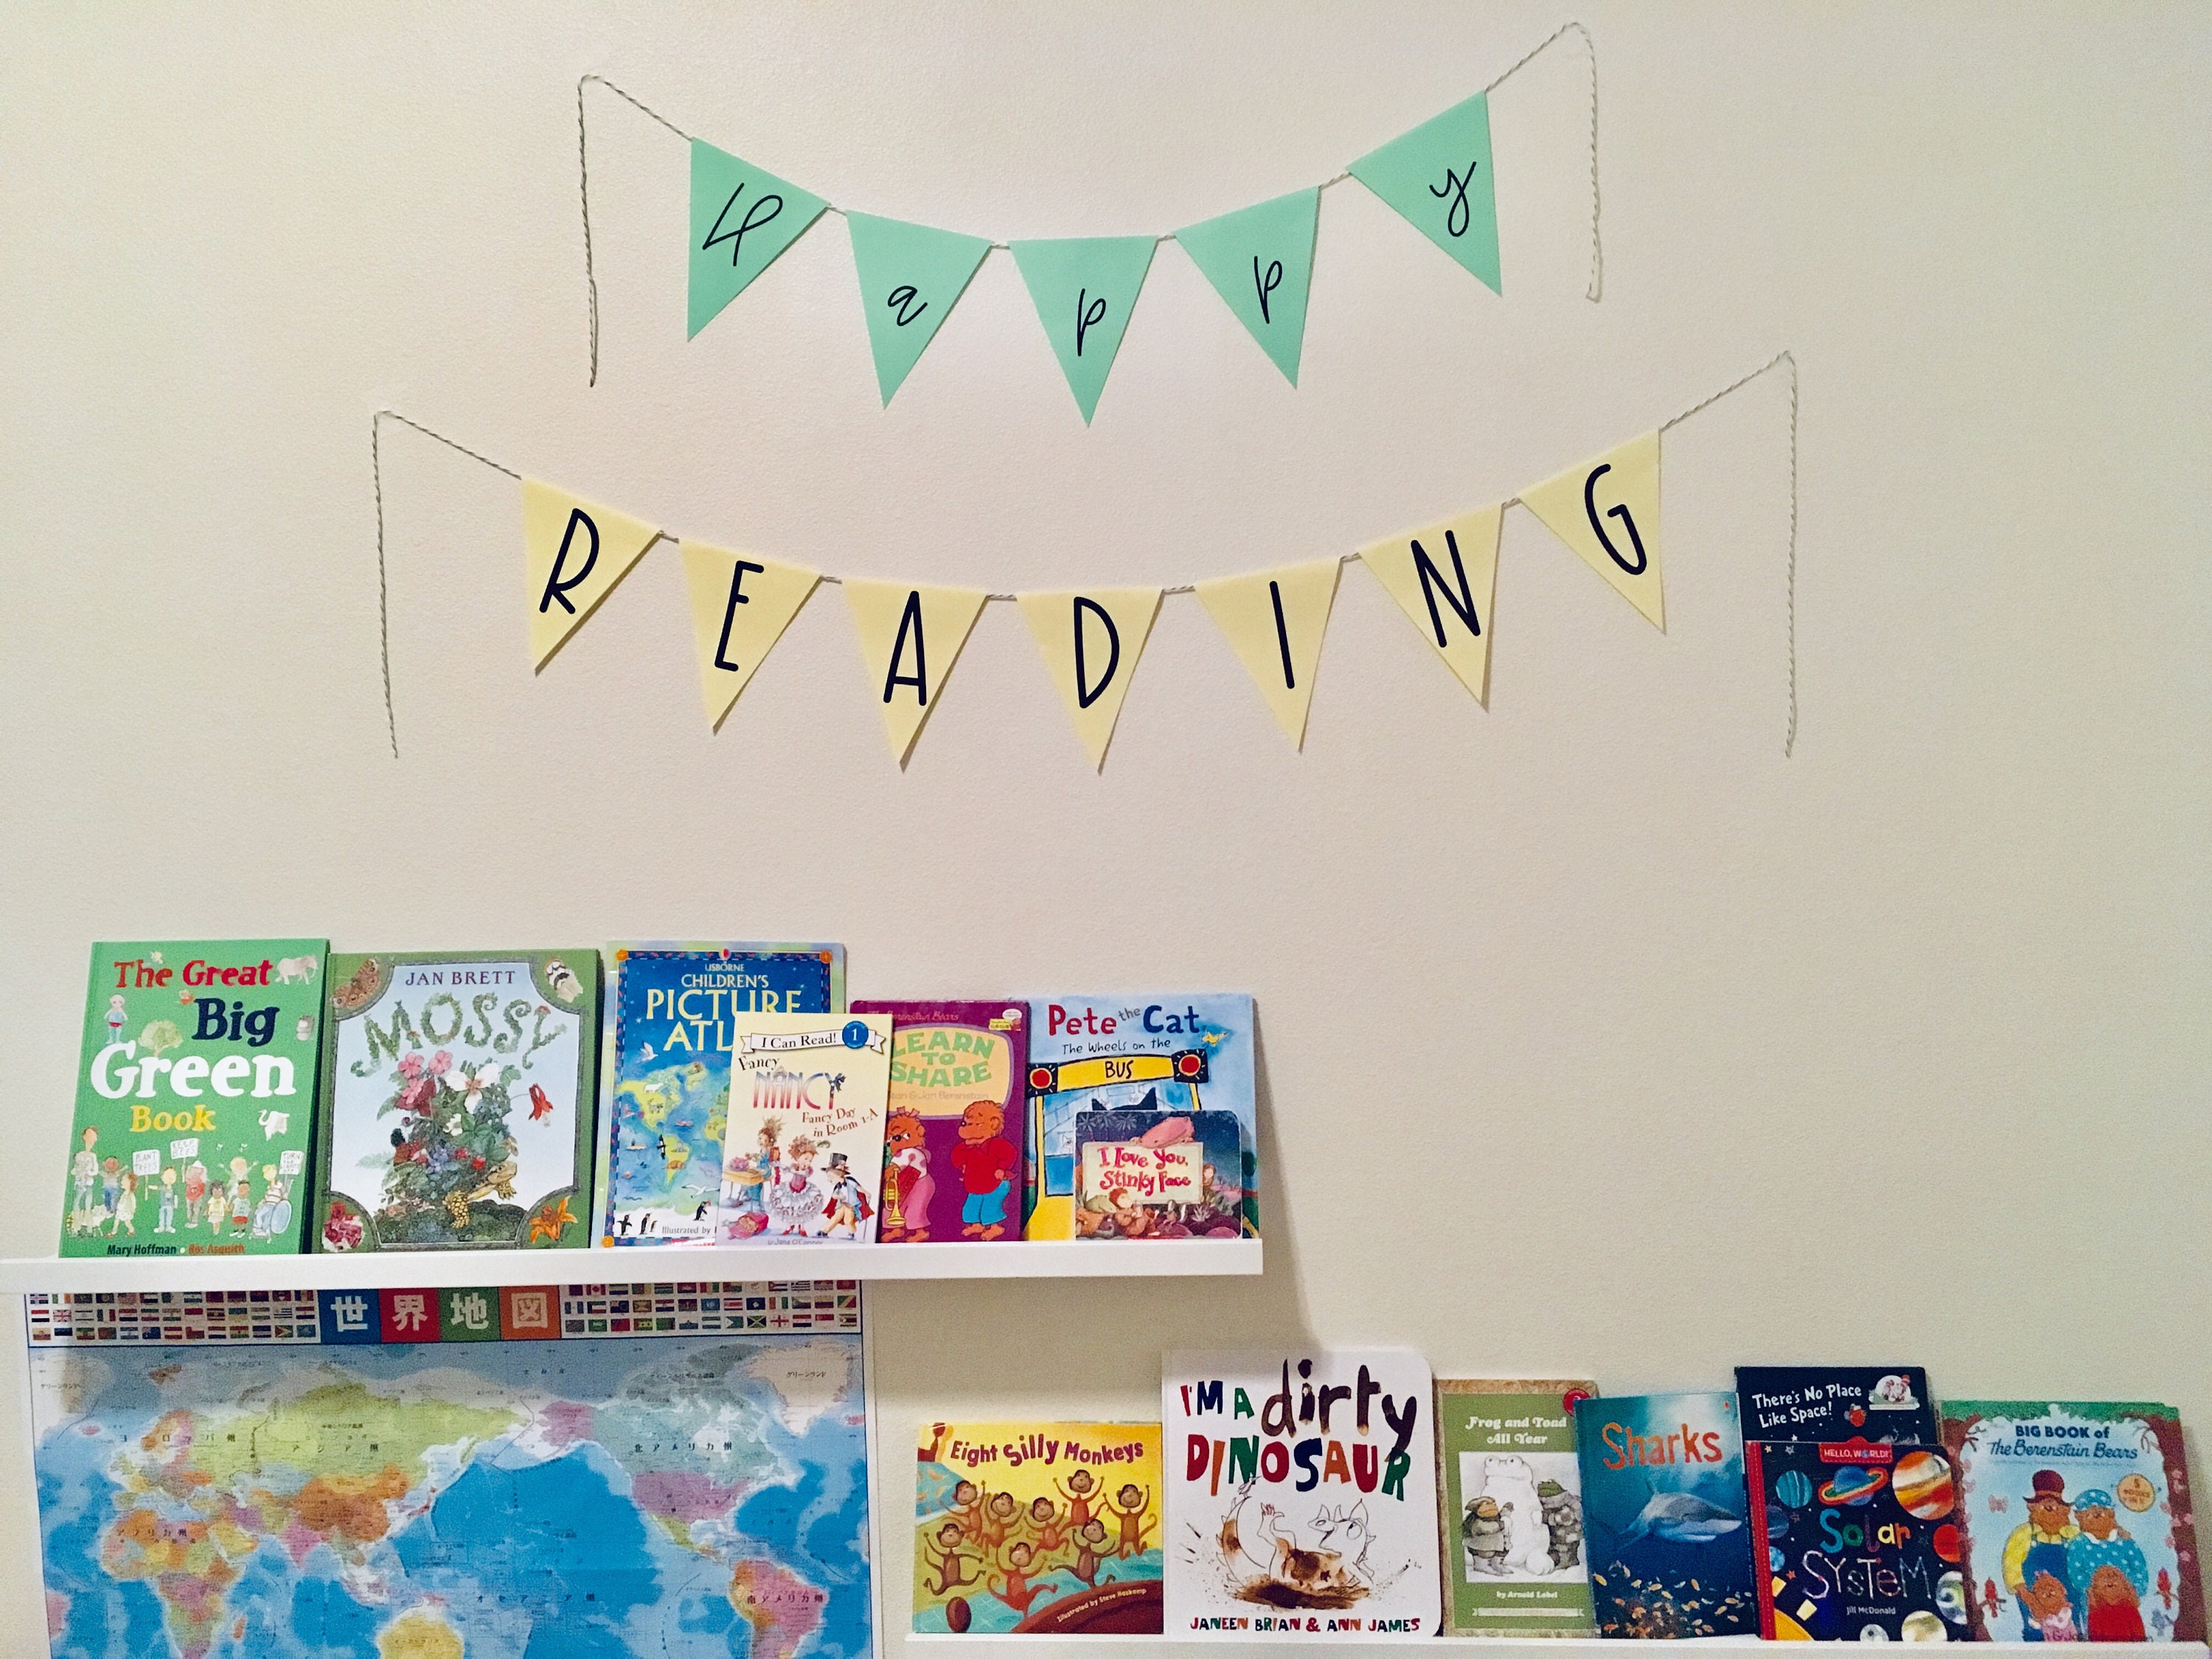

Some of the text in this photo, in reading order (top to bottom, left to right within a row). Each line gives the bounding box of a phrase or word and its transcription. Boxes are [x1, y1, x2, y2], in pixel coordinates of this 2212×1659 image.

[539, 463, 1648, 709] READING
[114, 959, 274, 988] The Great
[406, 970, 515, 986] JAN BRETT
[705, 964, 745, 972] USBORNE
[681, 974, 769, 988] CHILDREN'S
[192, 997, 279, 1047] Big
[932, 1011, 959, 1020] Bears
[1048, 1004, 1200, 1036] Pete the Cat
[350, 992, 568, 1077] MOSSY
[762, 1028, 858, 1048] I Can Read! 1
[894, 1031, 995, 1059] LEARN
[1062, 1044, 1082, 1055] The
[1088, 1040, 1127, 1051] Wheels
[1151, 1038, 1171, 1048] the
[90, 1040, 296, 1099] Green
[738, 1056, 781, 1071] Fancy
[921, 1052, 956, 1065] TO
[1105, 1060, 1134, 1079] BUS
[891, 1060, 992, 1087] SHARE
[753, 1069, 846, 1110] NANCY
[129, 1105, 216, 1133] Book
[802, 1107, 856, 1123] Fancy Day
[813, 1127, 823, 1137] in
[827, 1121, 858, 1136] Room
[1097, 1146, 1189, 1170] I Love You,
[1099, 1170, 1192, 1197] Stinky Face
[702, 1227, 712, 1235] by
[107, 1245, 131, 1256] Mary
[134, 1244, 176, 1255] Hoffman
[331, 1292, 549, 1332] 世界地図
[1752, 1383, 1862, 1408] There's No Place
[1180, 1358, 1417, 1462] I'M A dirty
[1759, 1401, 1832, 1428] Like Space!
[1465, 1416, 1567, 1430] Frog and Toad
[2015, 1425, 2110, 1439] BIG BOOK of
[1486, 1432, 1548, 1444] All Year
[1601, 1422, 1723, 1470] Sharks
[1987, 1439, 2138, 1459] The Berenstain Bears
[950, 1433, 1144, 1467] Eight Silly Monkeys
[1186, 1434, 1411, 1502] DINOSAUR
[1057, 1602, 1089, 1622] Illustrated
[1099, 1593, 1116, 1603] Steve
[1117, 1588, 1147, 1597] Haskamp
[1496, 1590, 1506, 1599] by
[1846, 1606, 1896, 1615] Jill McDonald
[1190, 1617, 1420, 1632] JANEEN BRIAN & ANN JAMES
